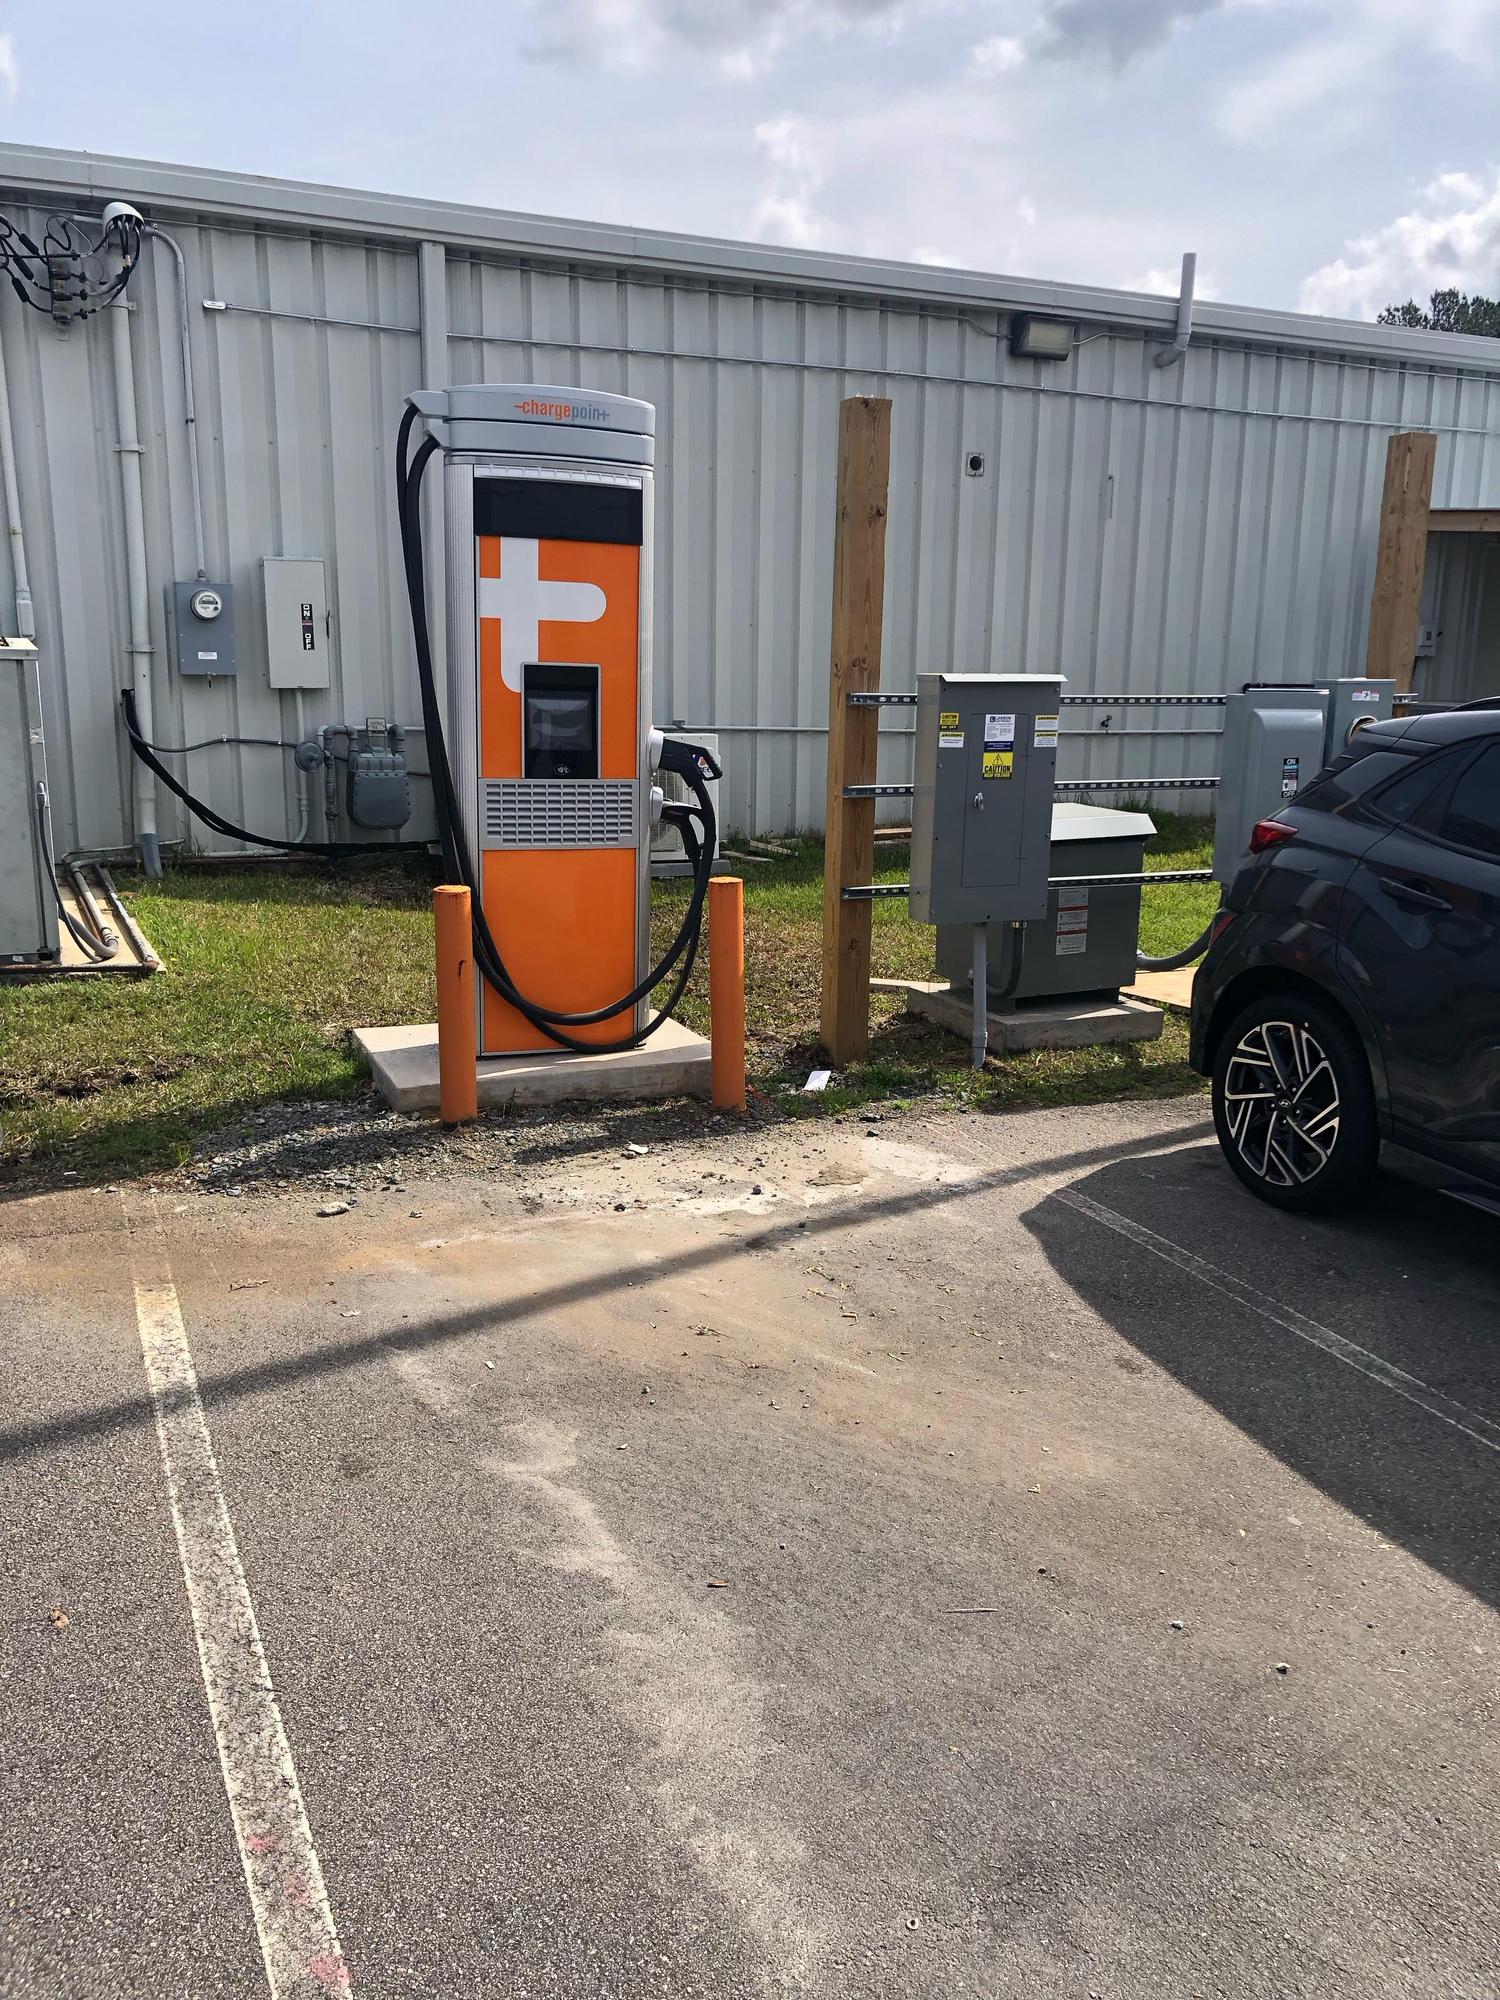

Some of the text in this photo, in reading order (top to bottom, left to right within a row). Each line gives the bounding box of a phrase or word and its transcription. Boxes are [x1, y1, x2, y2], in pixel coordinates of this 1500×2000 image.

[514, 400, 610, 421] chargepoint
[303, 604, 311, 616] ON
[984, 765, 1011, 773] CAUTION
